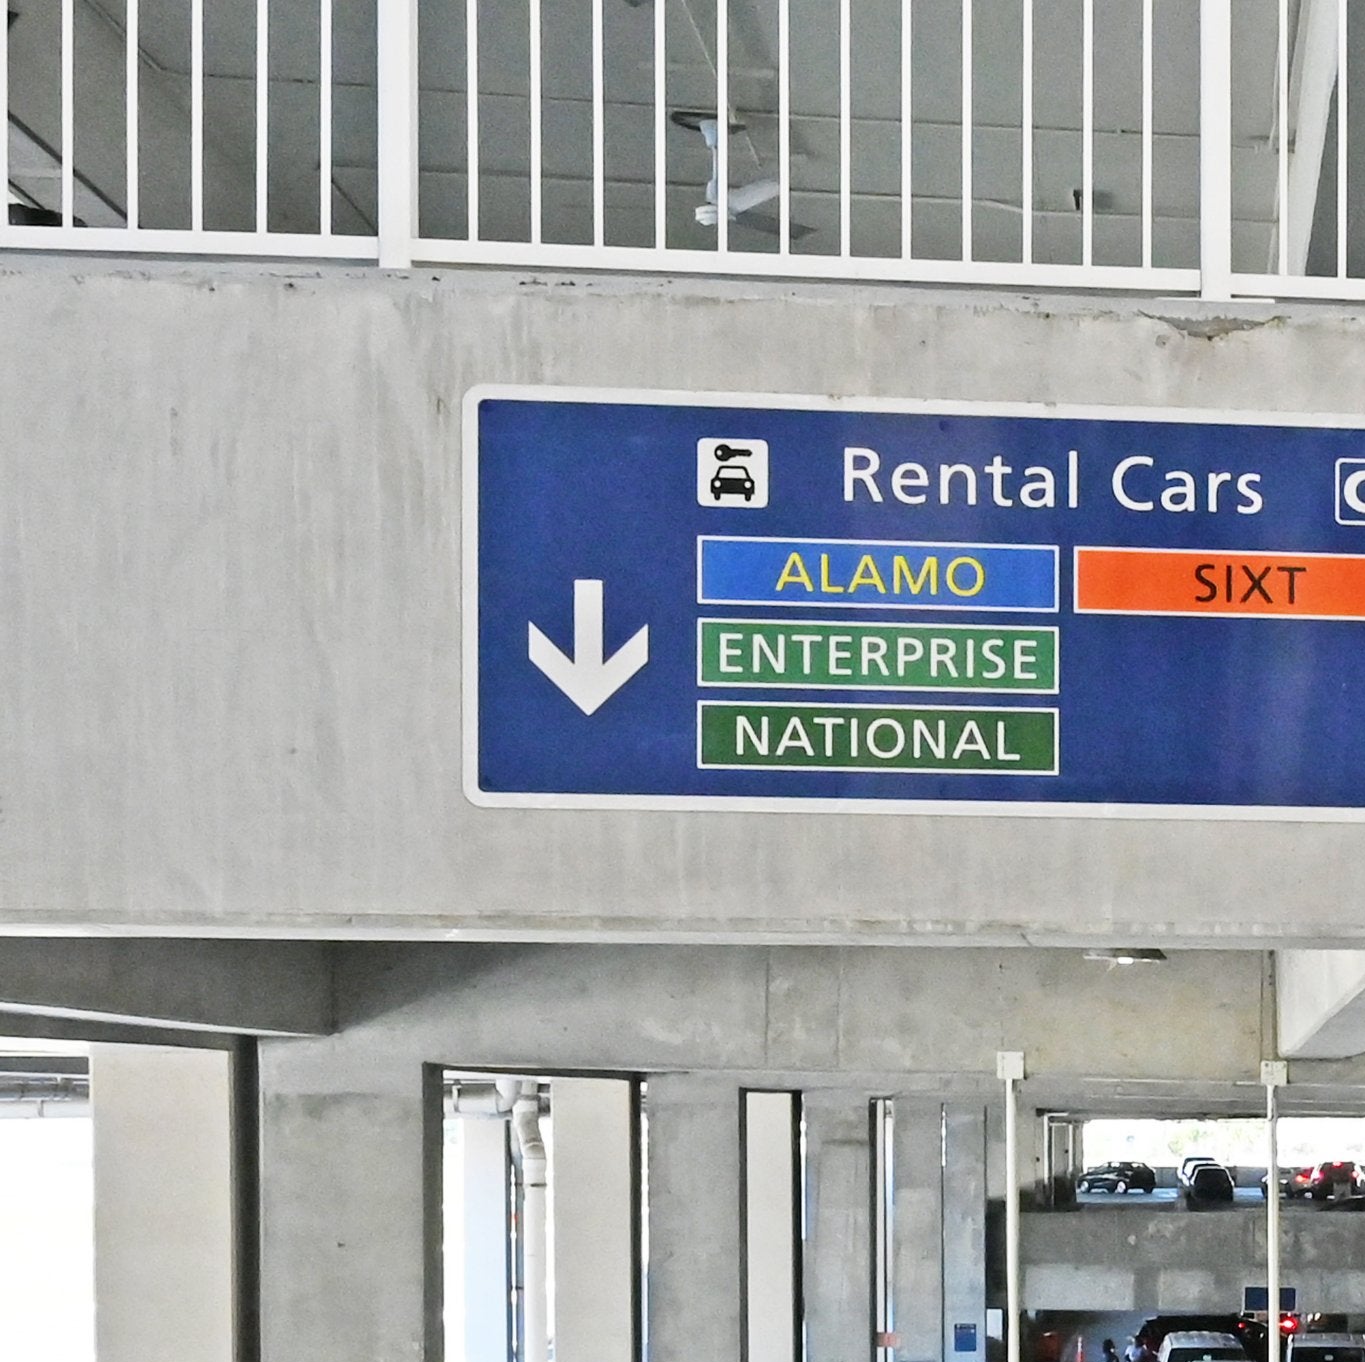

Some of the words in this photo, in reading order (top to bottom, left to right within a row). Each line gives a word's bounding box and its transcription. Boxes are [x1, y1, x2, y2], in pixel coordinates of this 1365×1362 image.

[843, 447, 1078, 512] Rental
[1111, 455, 1264, 516] Cars
[775, 551, 986, 596] ALAMO
[1194, 563, 1306, 607] SIXT
[717, 633, 1037, 681] ENTERPRISE
[736, 715, 1020, 763] NATIONAL
